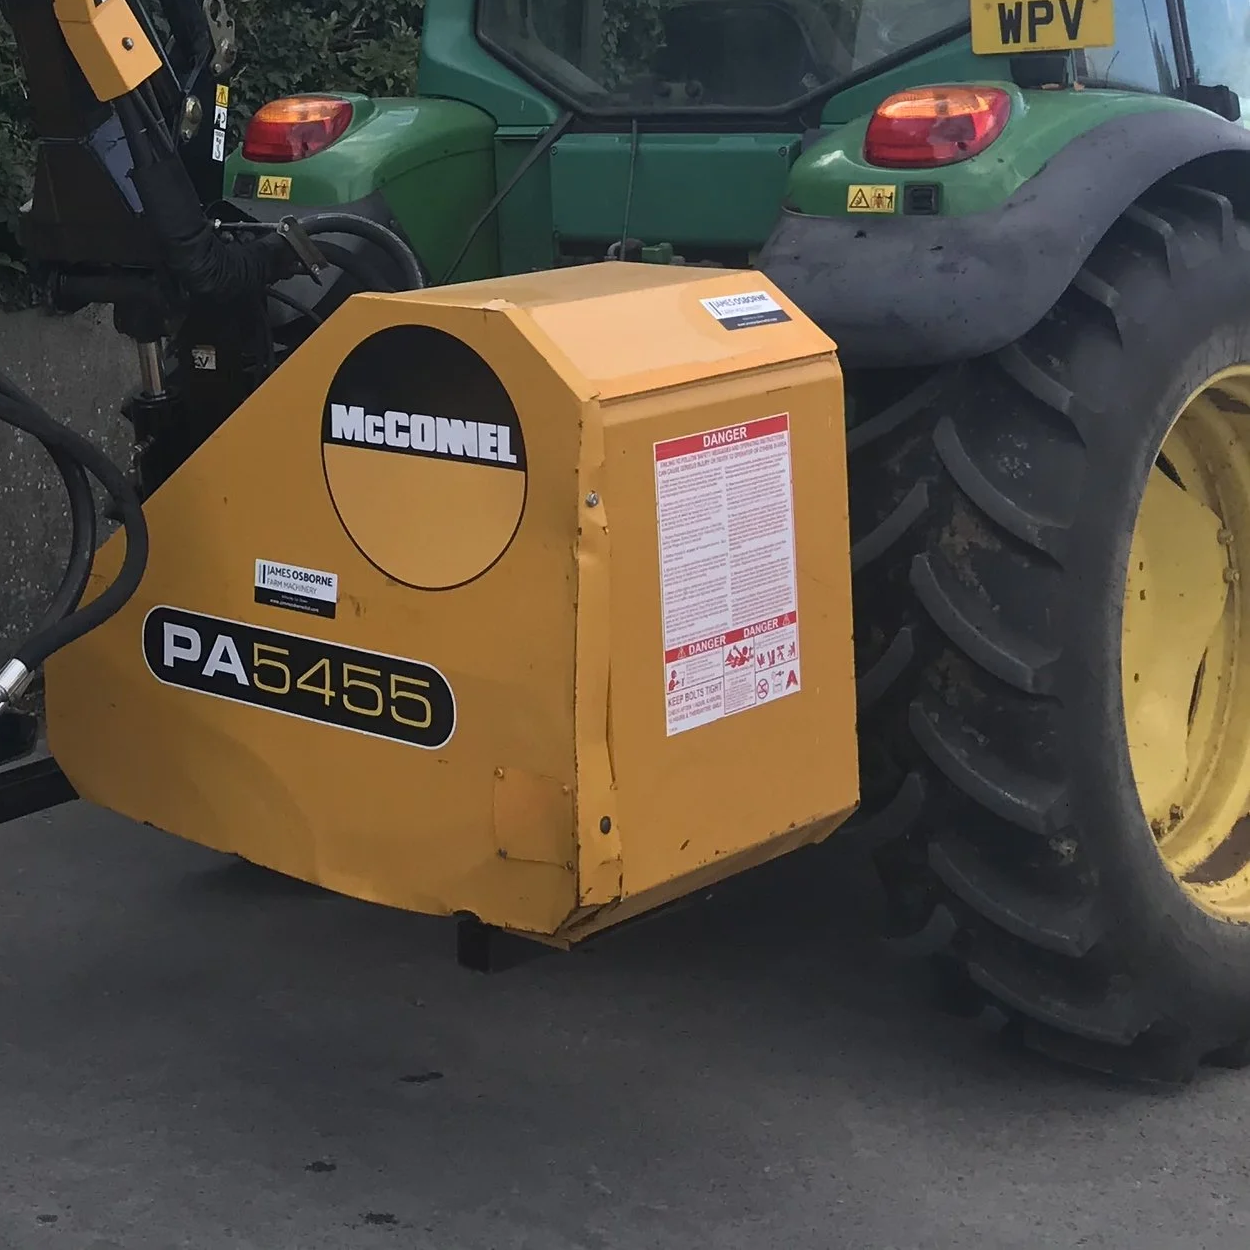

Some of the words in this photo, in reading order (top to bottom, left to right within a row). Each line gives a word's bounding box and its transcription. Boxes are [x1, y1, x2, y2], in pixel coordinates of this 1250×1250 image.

[331, 403, 517, 464] McCONNEL
[703, 426, 748, 448] DANGER
[267, 565, 291, 579] JAMES
[292, 570, 334, 587] OSBORNE
[743, 618, 779, 639] DANGER
[688, 635, 727, 656] DANGER
[163, 621, 432, 729] PA5455
[685, 687, 704, 702] BOLTS
[705, 681, 722, 695] TIGHT
